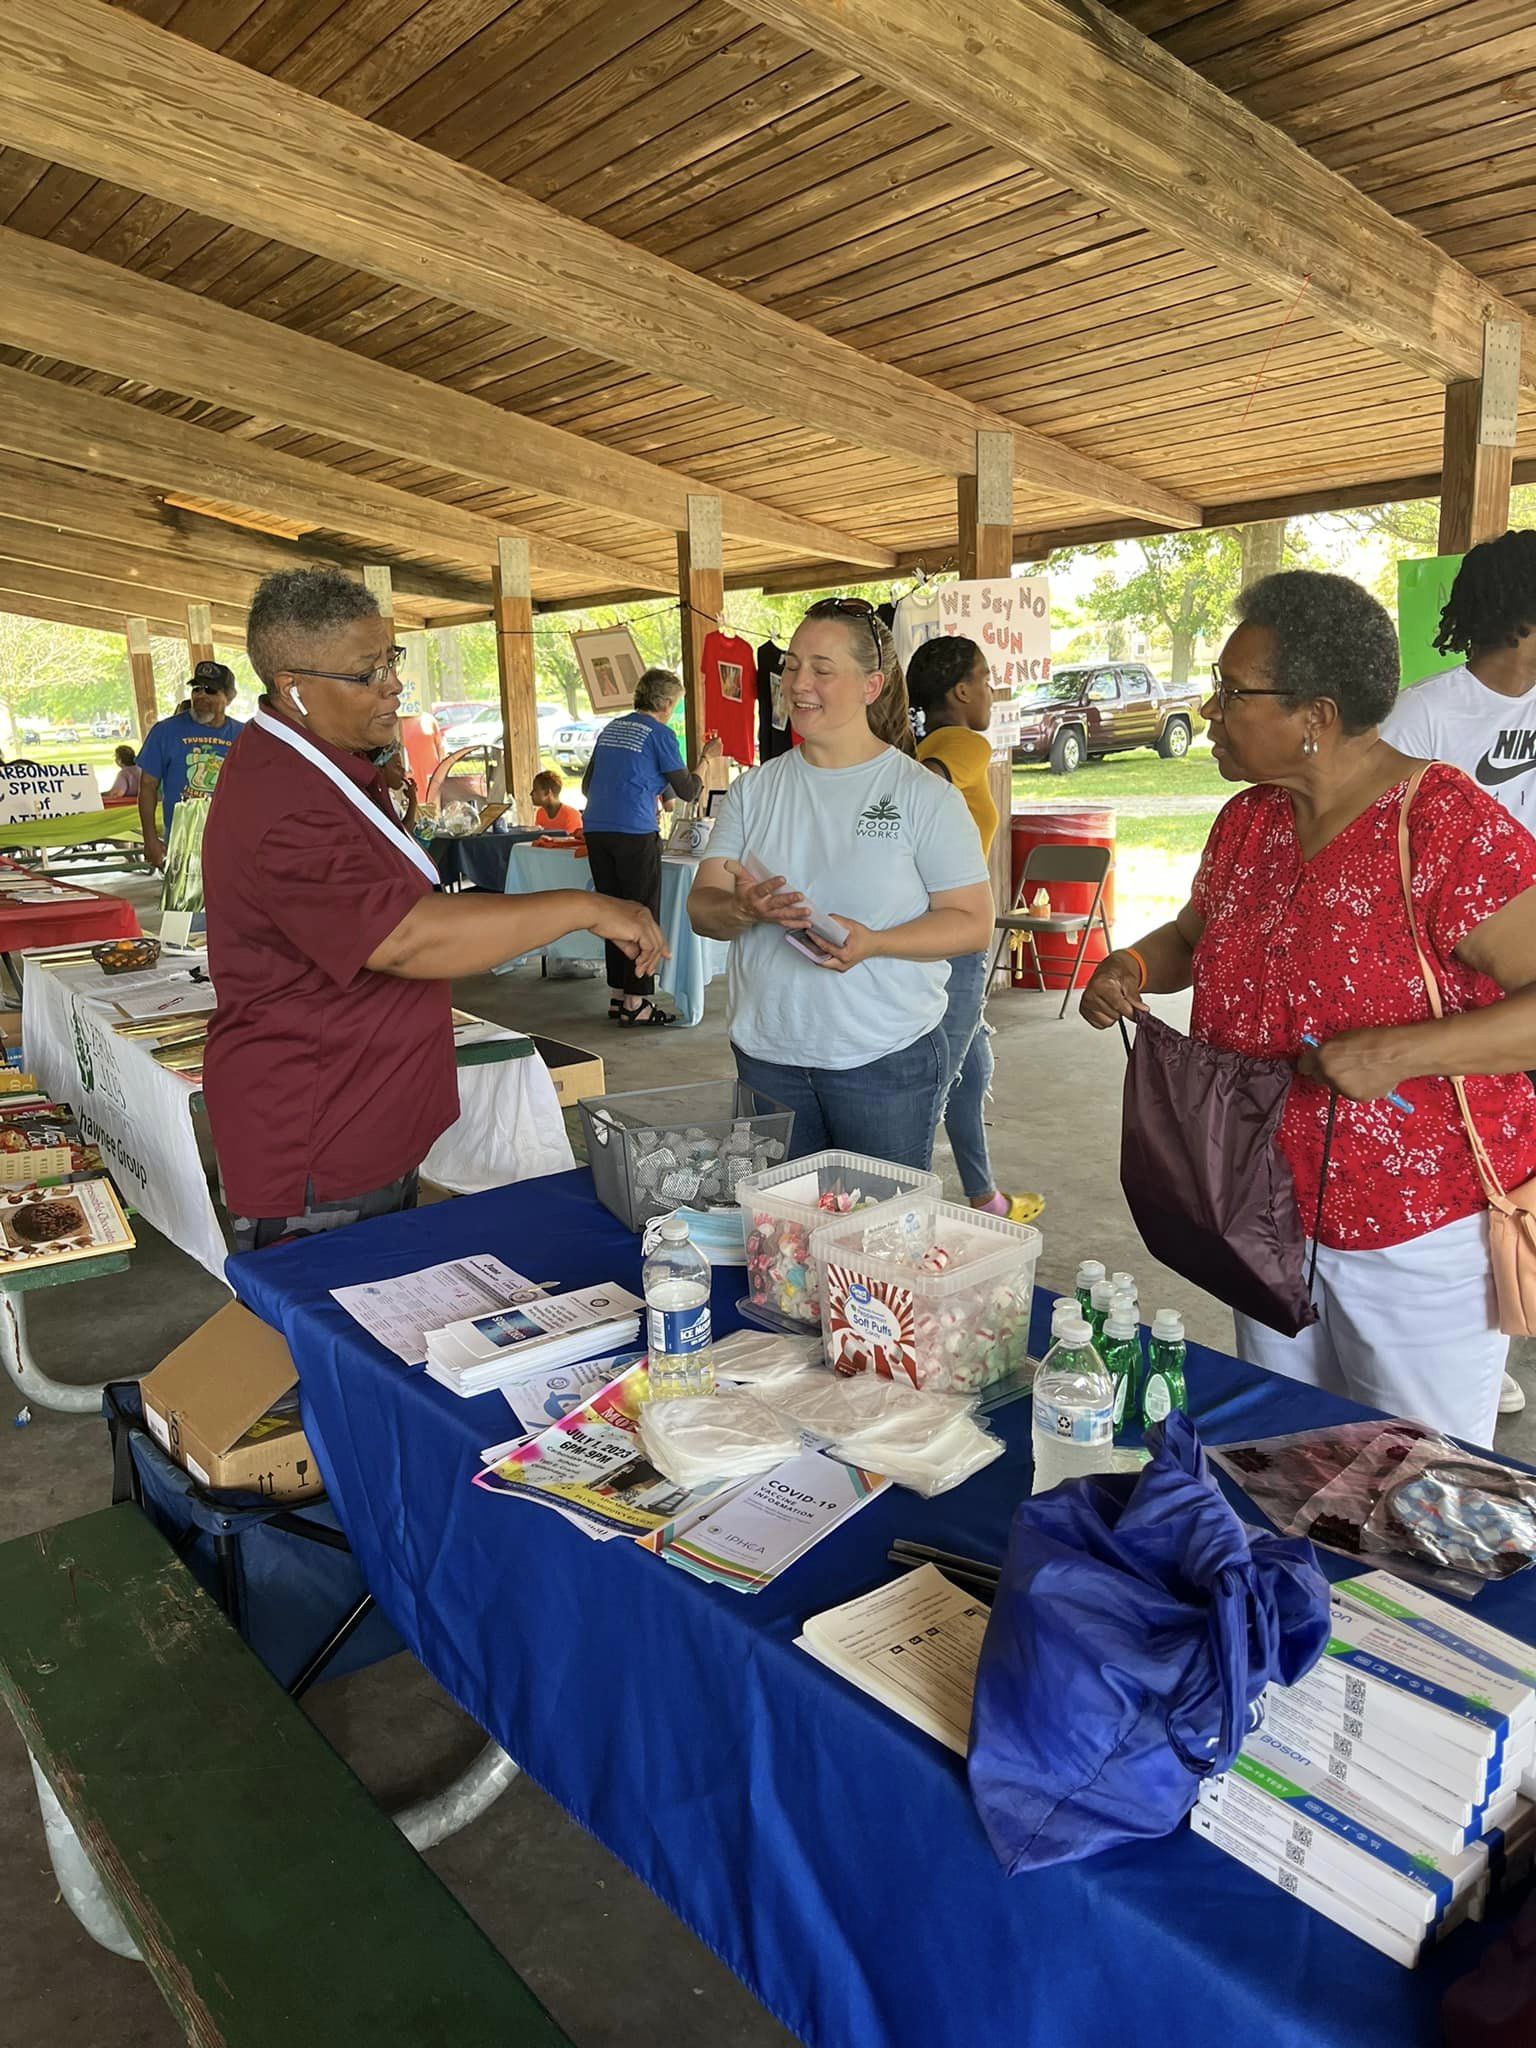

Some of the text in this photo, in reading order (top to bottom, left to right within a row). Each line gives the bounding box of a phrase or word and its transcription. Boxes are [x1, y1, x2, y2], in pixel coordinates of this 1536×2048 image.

[941, 591, 971, 617] WE
[1019, 586, 1046, 618] NO
[982, 622, 1023, 655] GUN
[991, 657, 1052, 687] LENCE
[9, 780, 64, 795] SPIRIT
[855, 829, 898, 840] WORKS
[857, 819, 900, 831] FOOD
[78, 1104, 117, 1158] hawnee
[116, 1137, 148, 1190] Group
[680, 1329, 695, 1341] ICE
[853, 1314, 892, 1337] Soft Puffs
[559, 1440, 613, 1465] 6PM-9PM
[566, 1428, 595, 1446] JULY
[601, 1443, 633, 1459] 2023
[753, 1490, 815, 1519] INFORMATION
[760, 1486, 798, 1507] VACCINE
[768, 1480, 837, 1511] COVID-19
[725, 1533, 766, 1555] IPHCA
[1266, 1776, 1289, 1793] TEST
